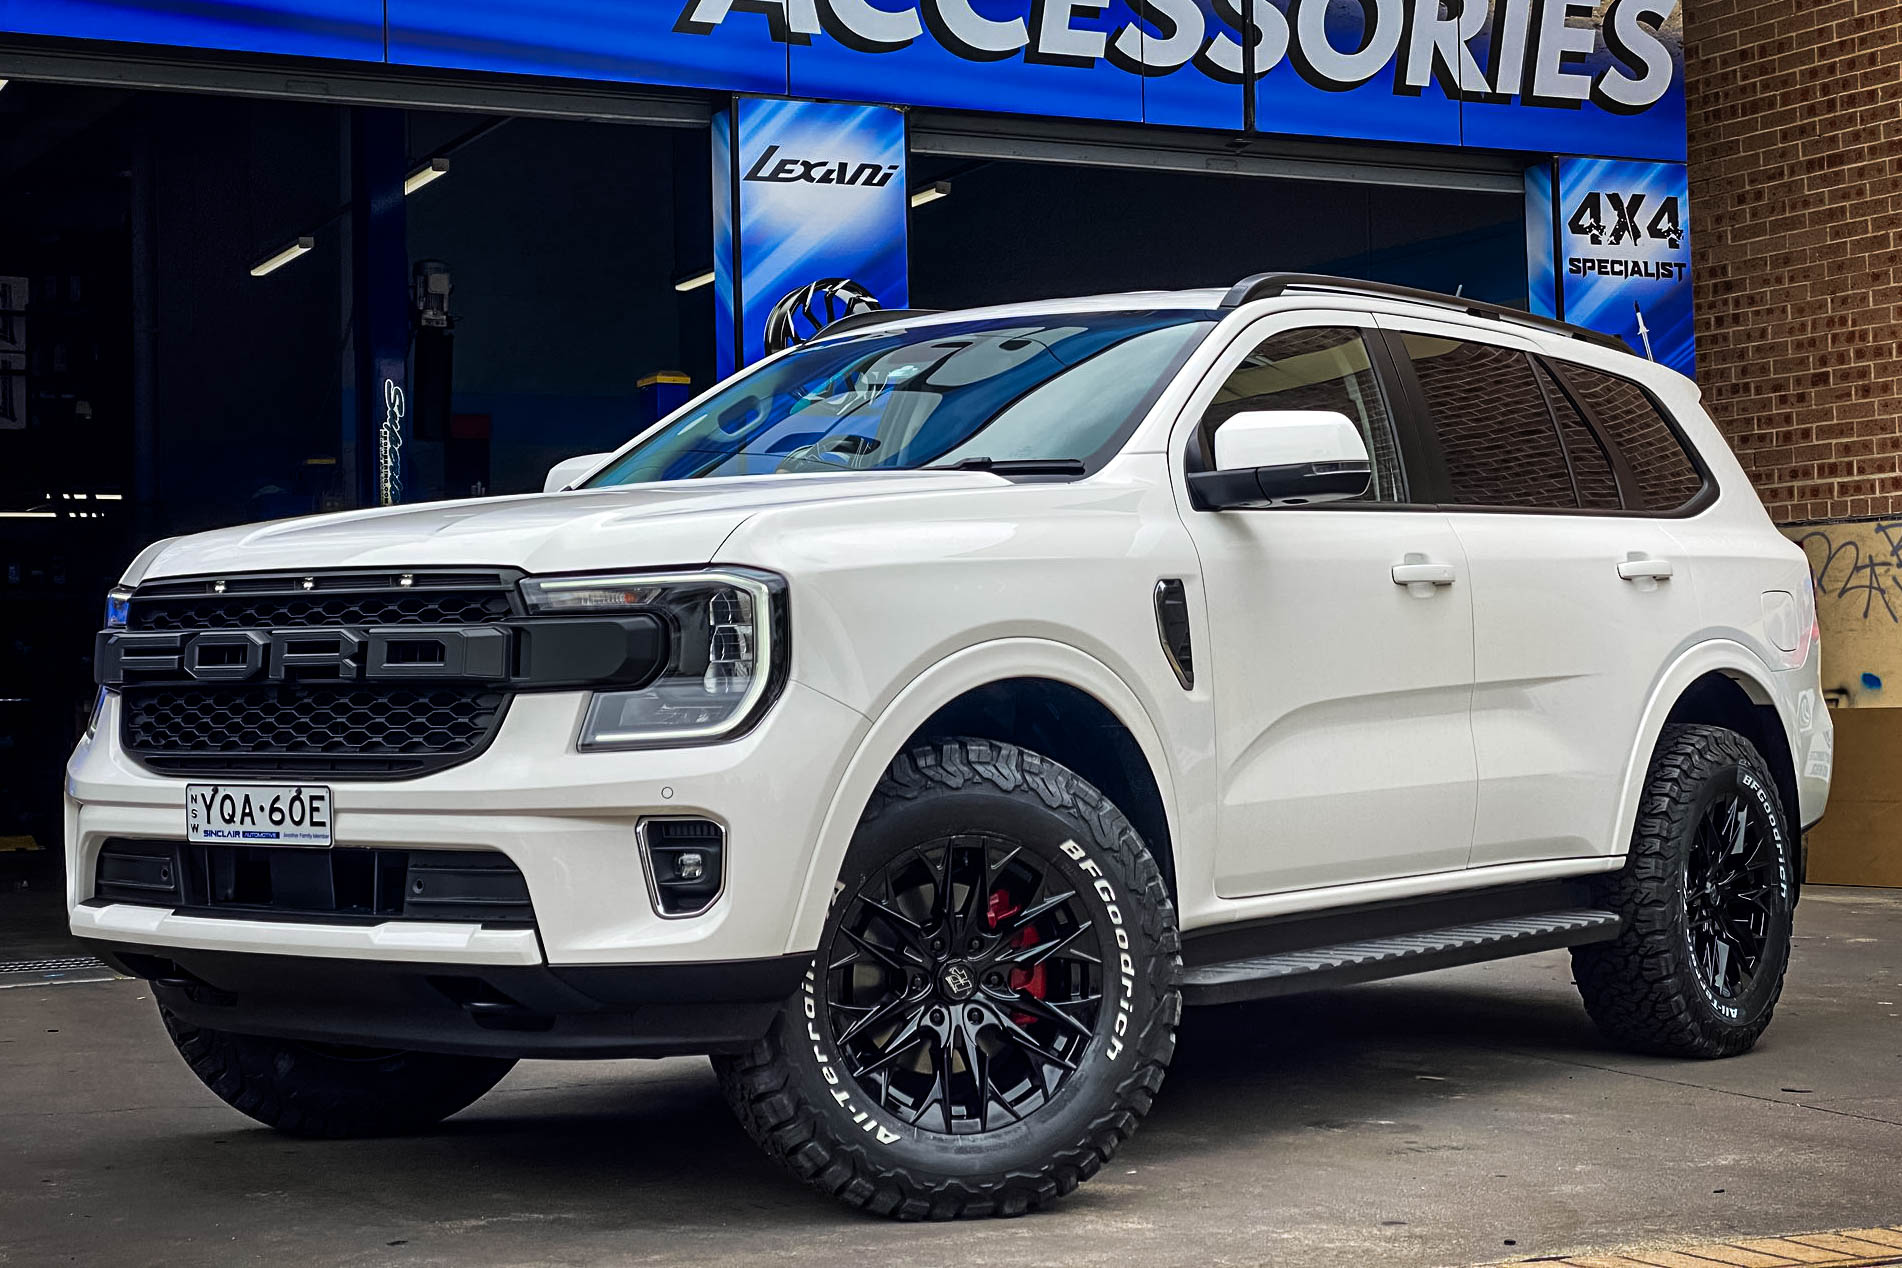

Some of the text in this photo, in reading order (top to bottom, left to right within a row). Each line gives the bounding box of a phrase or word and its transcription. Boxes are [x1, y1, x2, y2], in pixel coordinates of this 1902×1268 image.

[682, 0, 1676, 108] SSORIES
[1568, 257, 1686, 281] SPECIALIST
[97, 627, 469, 683] FORD
[203, 829, 241, 839] SINCLAIR
[243, 831, 281, 839] AUTOMOTIVE
[1058, 838, 1136, 1062] BFGoodrich
